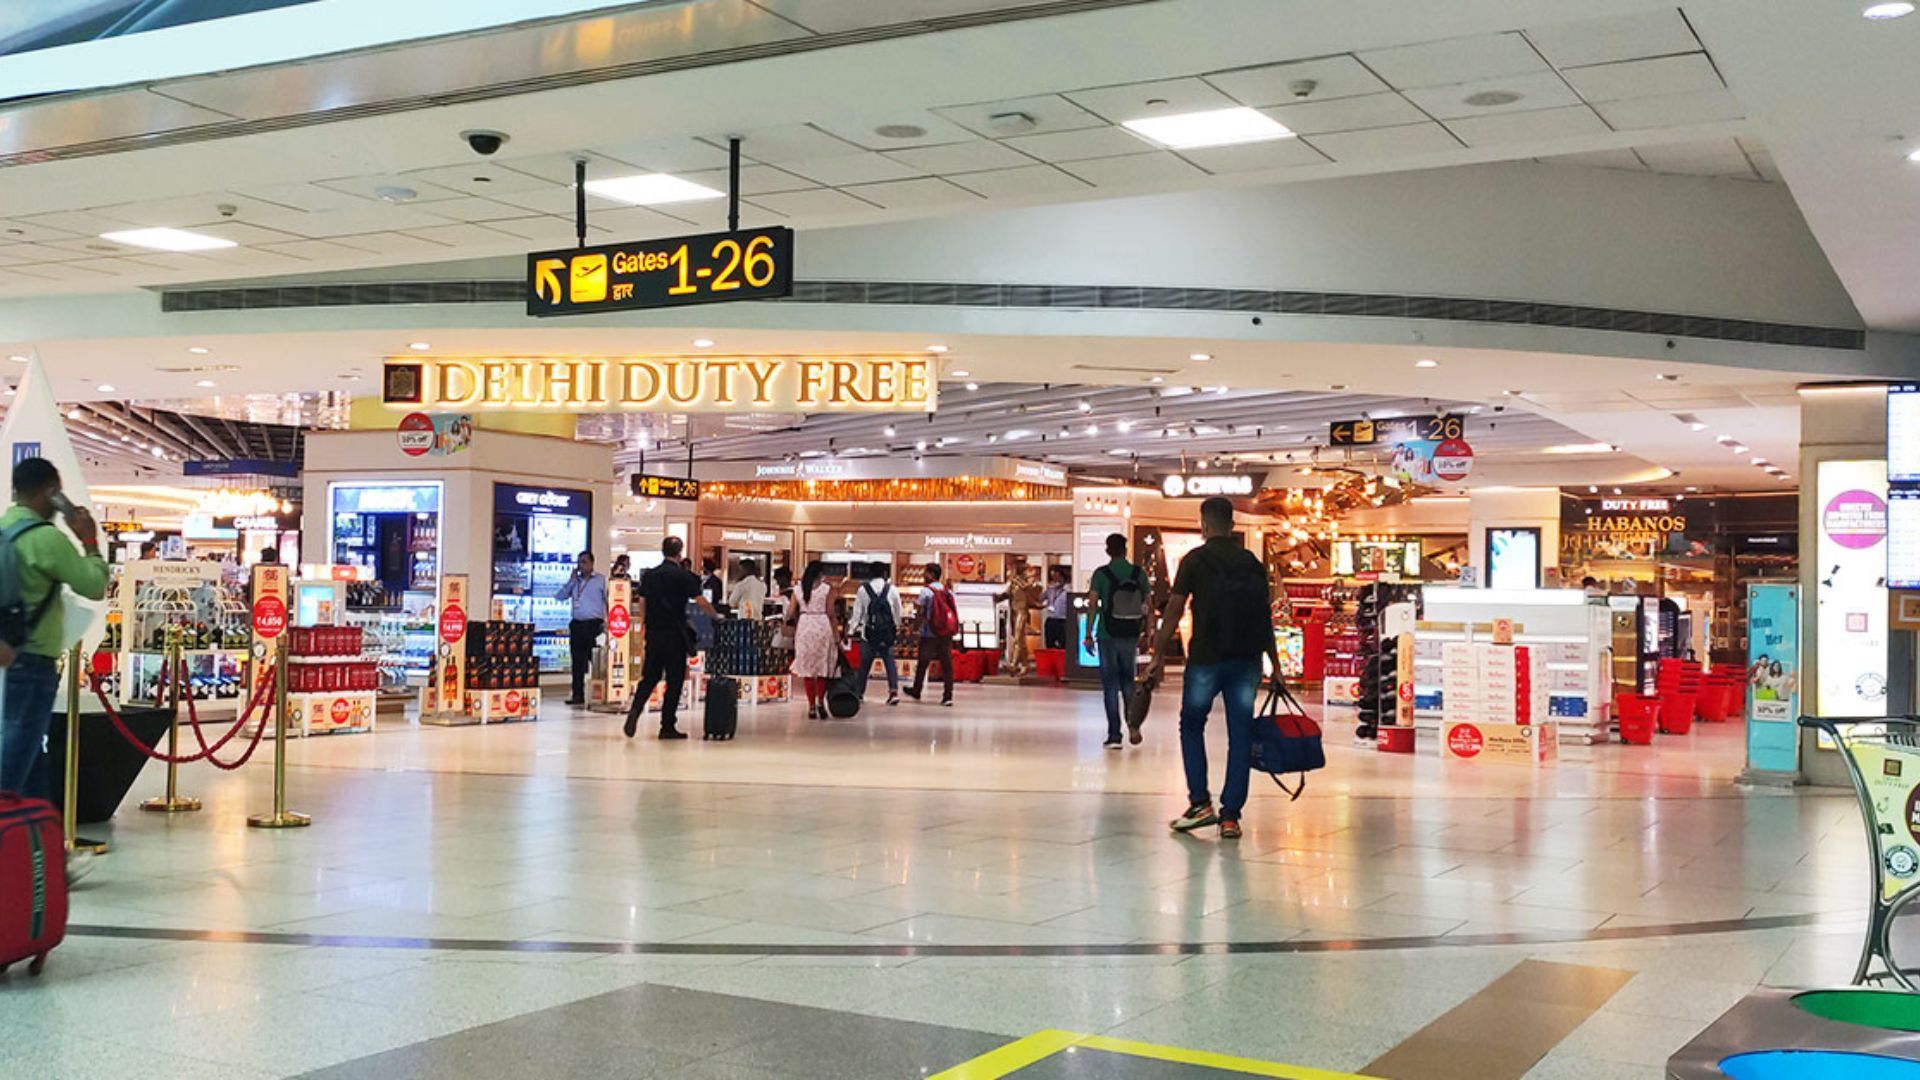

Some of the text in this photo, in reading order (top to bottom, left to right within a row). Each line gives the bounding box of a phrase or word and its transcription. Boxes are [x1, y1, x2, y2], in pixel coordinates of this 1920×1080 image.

[612, 235, 775, 295] Gates 1-26
[612, 283, 634, 301] द्वार
[435, 361, 928, 403] DELHI DUTY FREE
[1407, 418, 1461, 440] 1-26
[755, 465, 843, 477] JOHNNIE WALKER
[674, 480, 698, 497] 1-26
[1602, 500, 1638, 510] DUTY
[1587, 516, 1686, 532] HABANOS
[924, 535, 1013, 547] JOHNNIE WALKER
